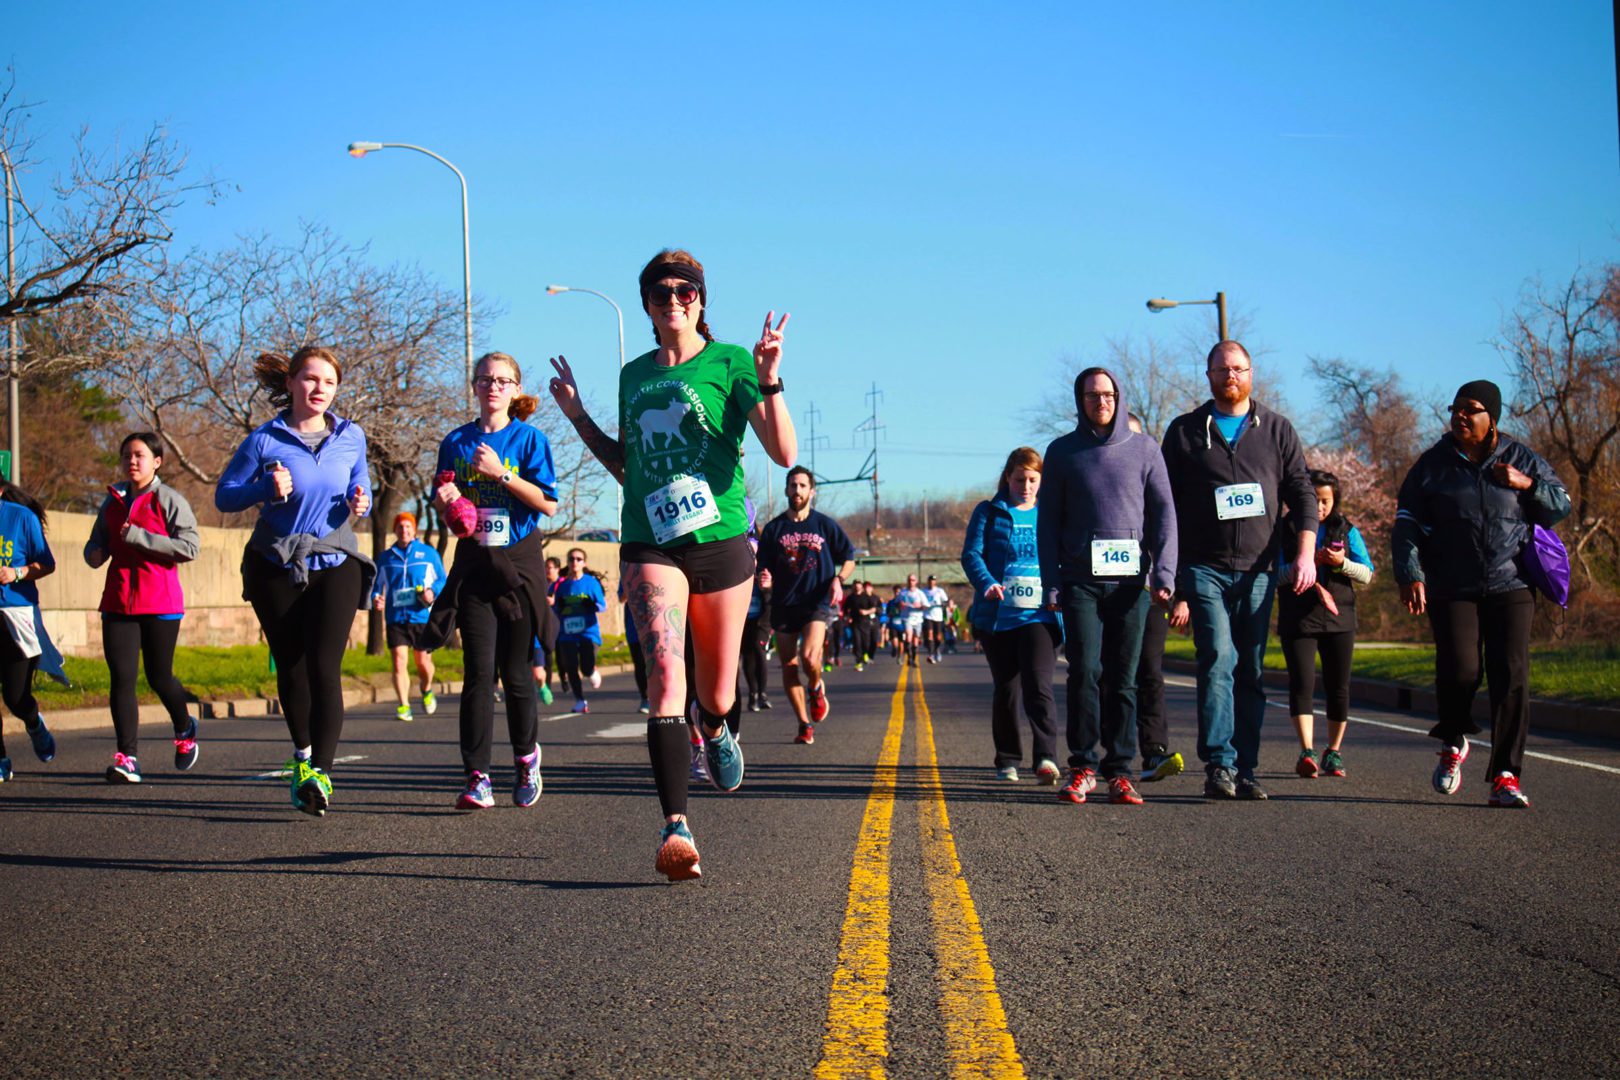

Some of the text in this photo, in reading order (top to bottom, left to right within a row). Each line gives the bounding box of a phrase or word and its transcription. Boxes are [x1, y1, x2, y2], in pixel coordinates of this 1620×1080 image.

[656, 380, 707, 425] COMPASSION
[654, 491, 707, 524] 1916
[1225, 493, 1254, 508] 169
[681, 509, 704, 522] VEGANS
[1101, 550, 1131, 564] 146
[1009, 585, 1034, 598] 160
